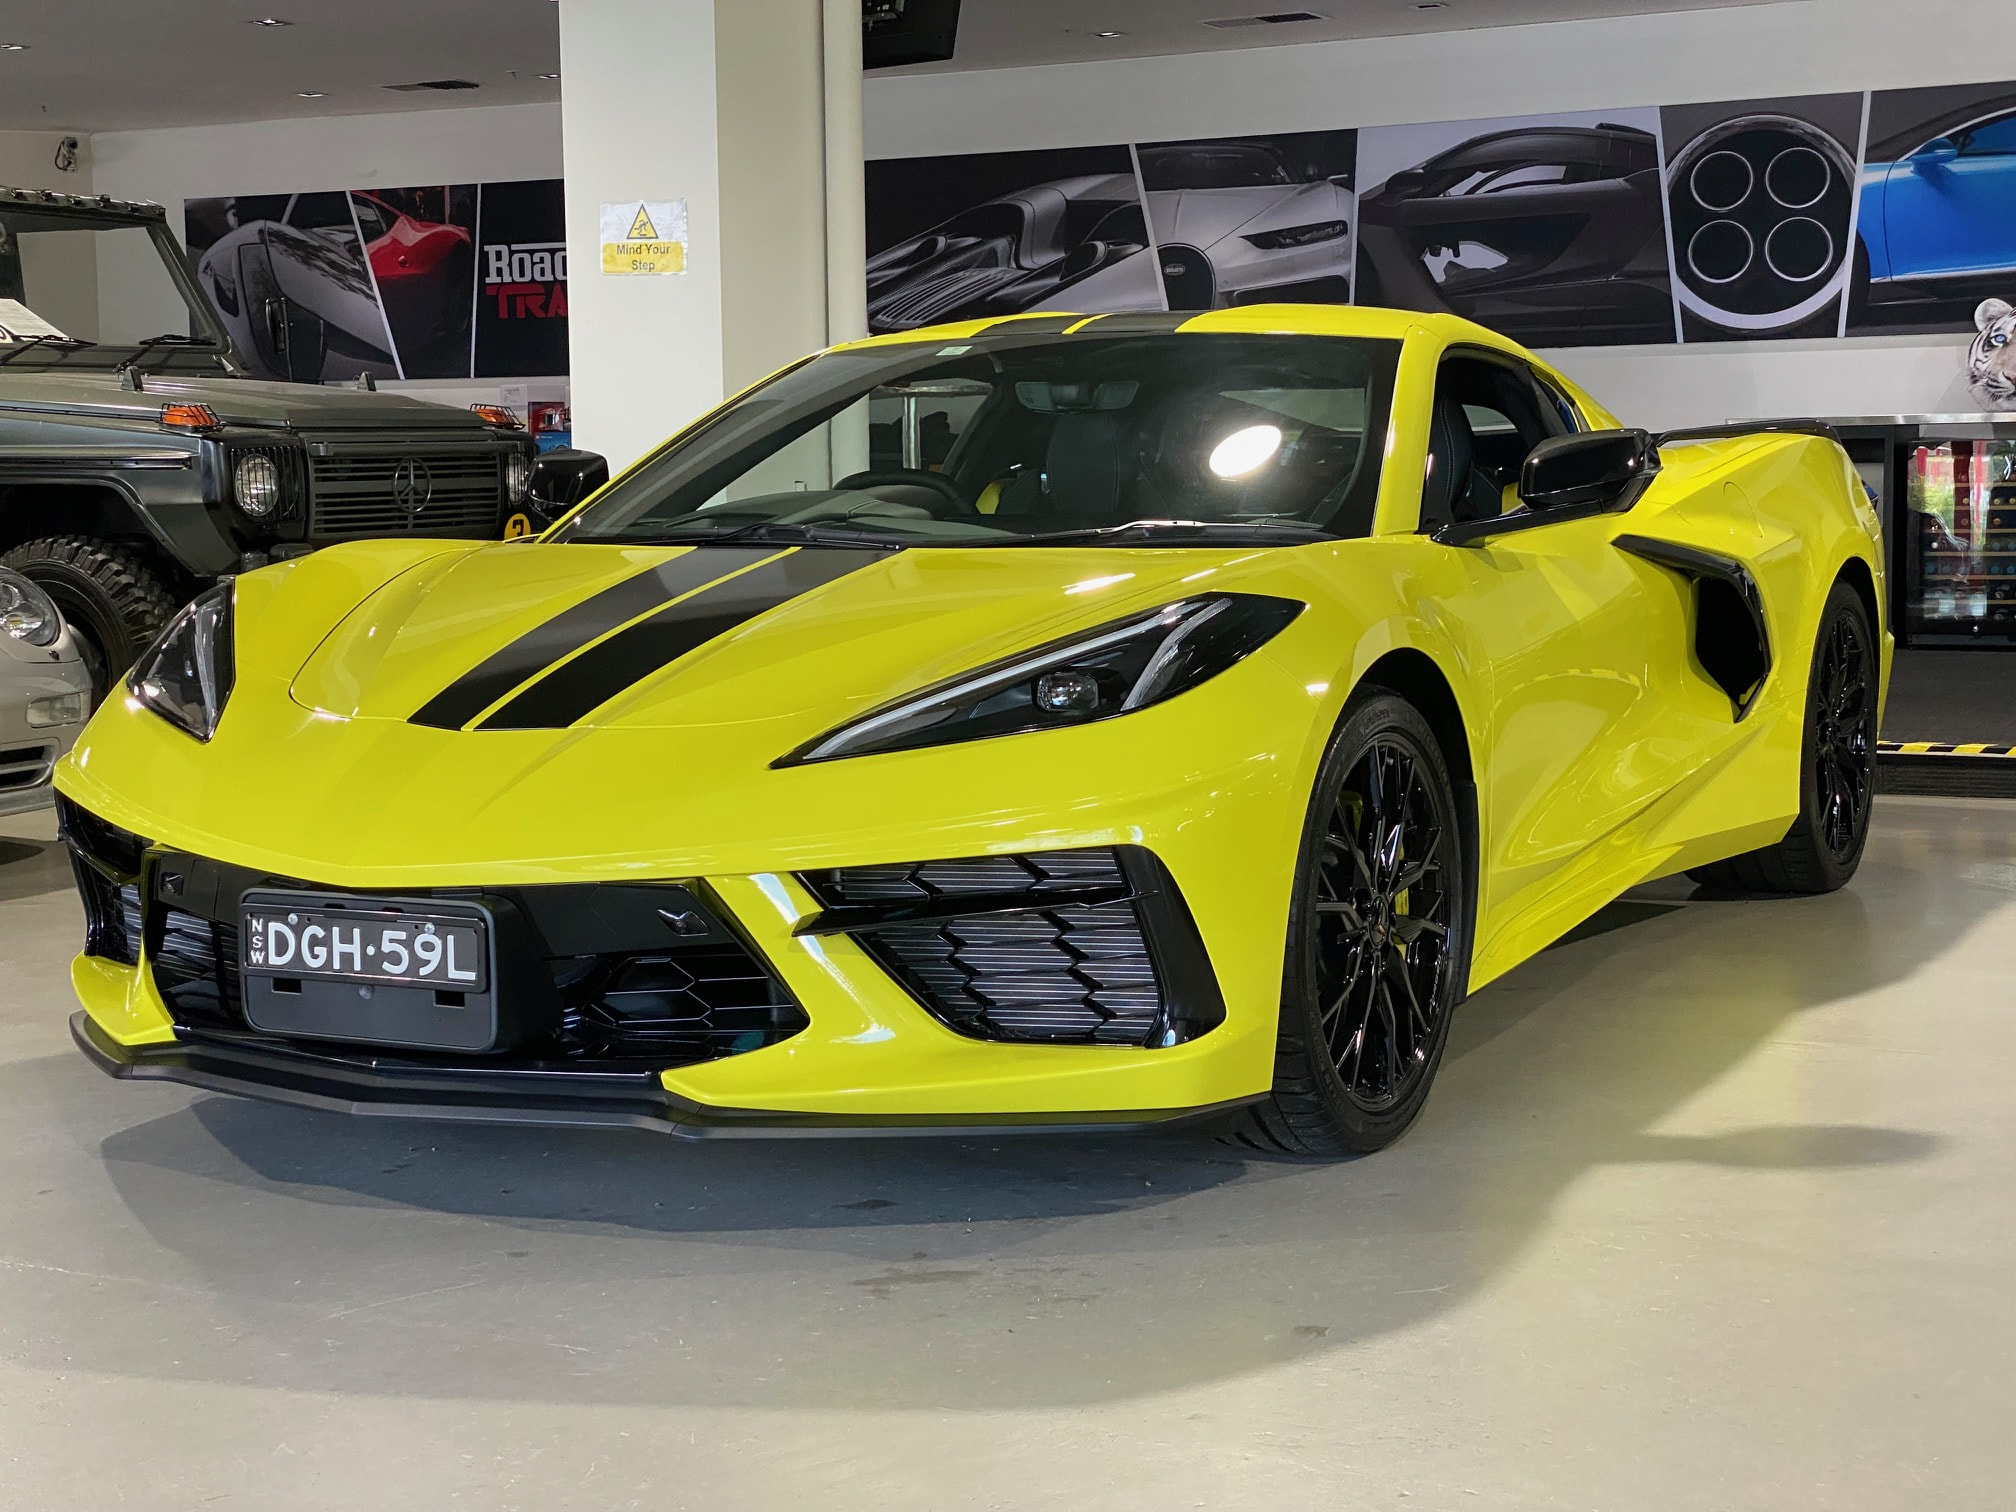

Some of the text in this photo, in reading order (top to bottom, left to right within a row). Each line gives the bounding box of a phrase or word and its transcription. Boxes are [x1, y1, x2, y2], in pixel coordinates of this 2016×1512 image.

[616, 243, 671, 255] Mind Your
[631, 259, 655, 272] Step
